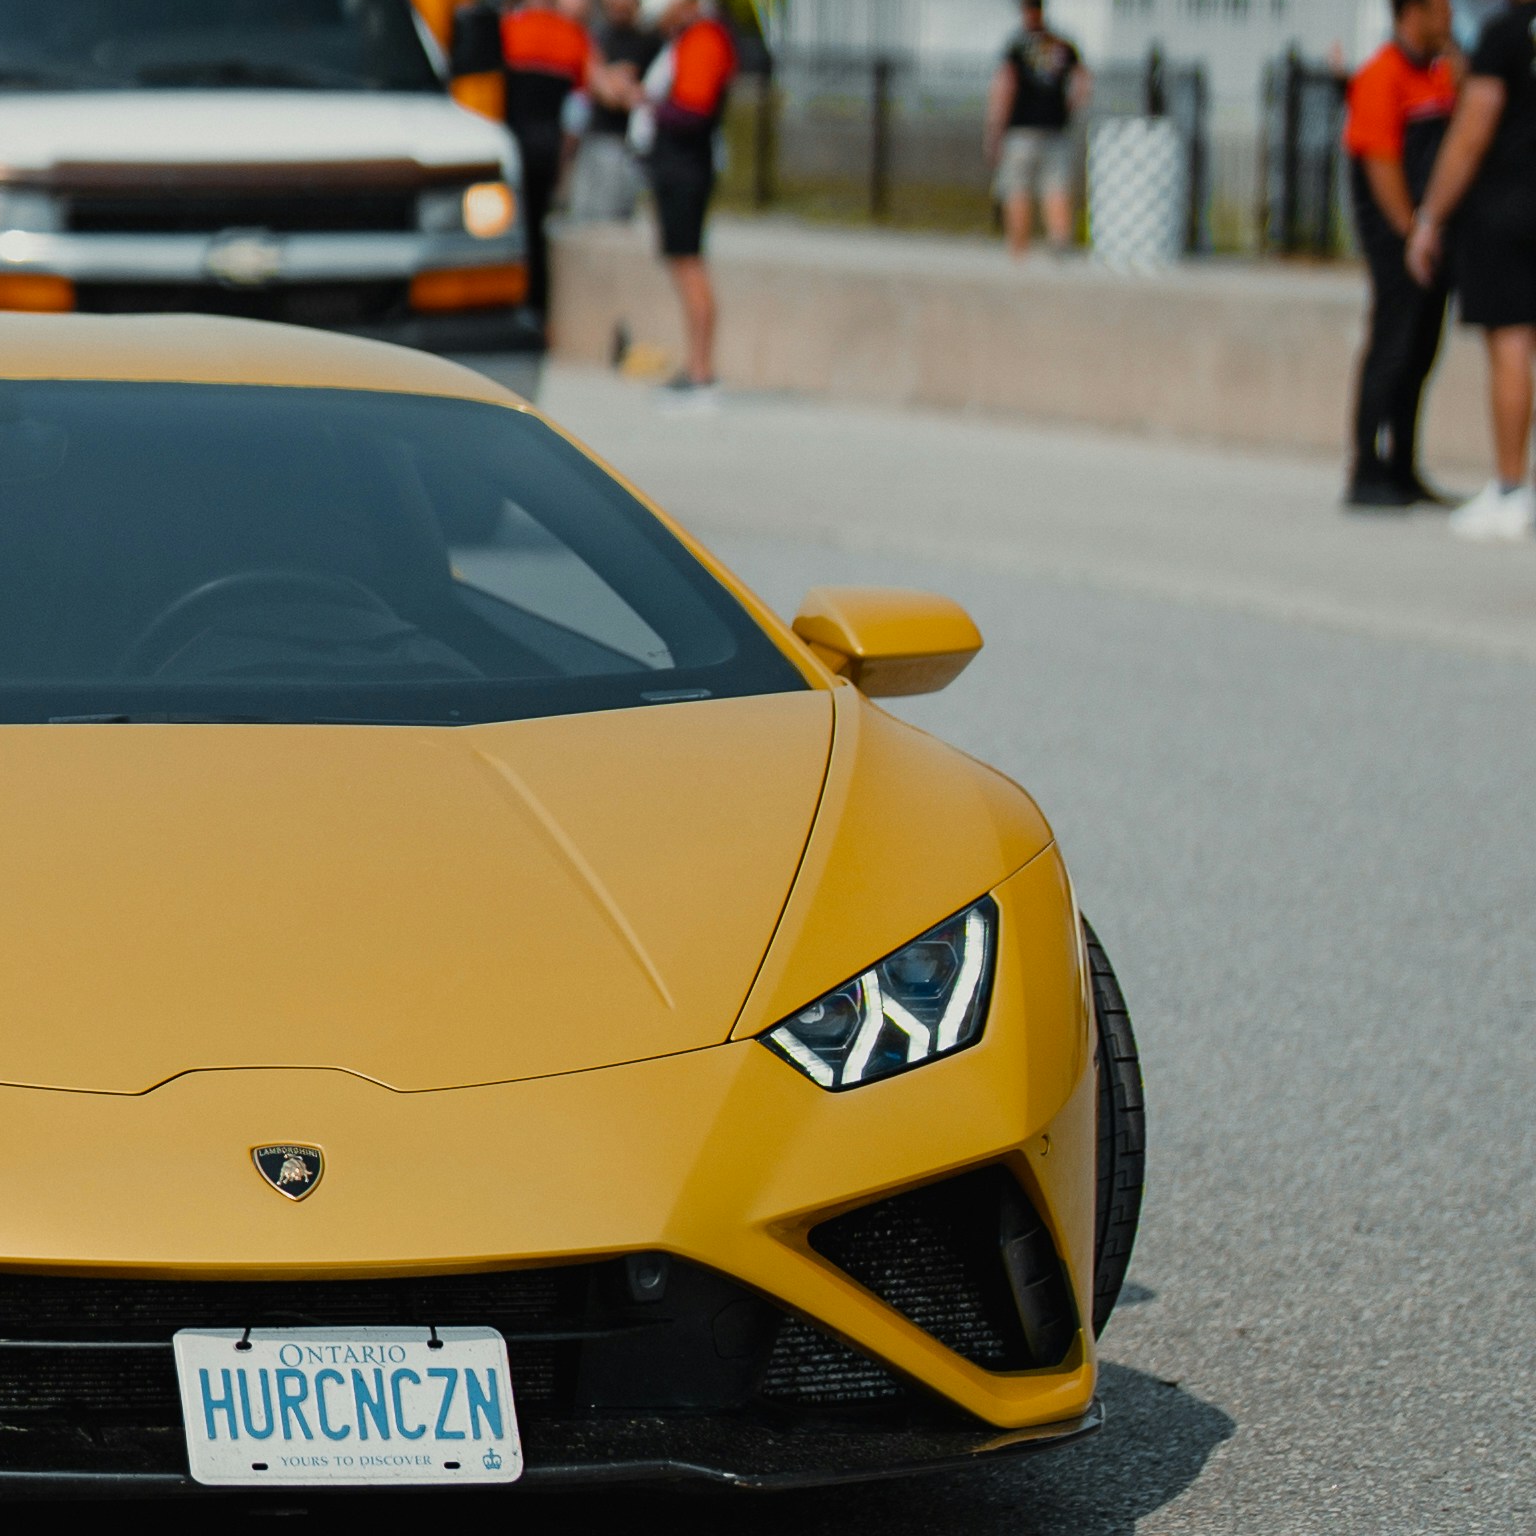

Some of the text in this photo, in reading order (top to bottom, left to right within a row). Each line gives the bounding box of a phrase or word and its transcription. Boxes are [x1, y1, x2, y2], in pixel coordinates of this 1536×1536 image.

[199, 1368, 504, 1440] HURCNCZN
[279, 1454, 432, 1467] YOURS TO DISCOVER
